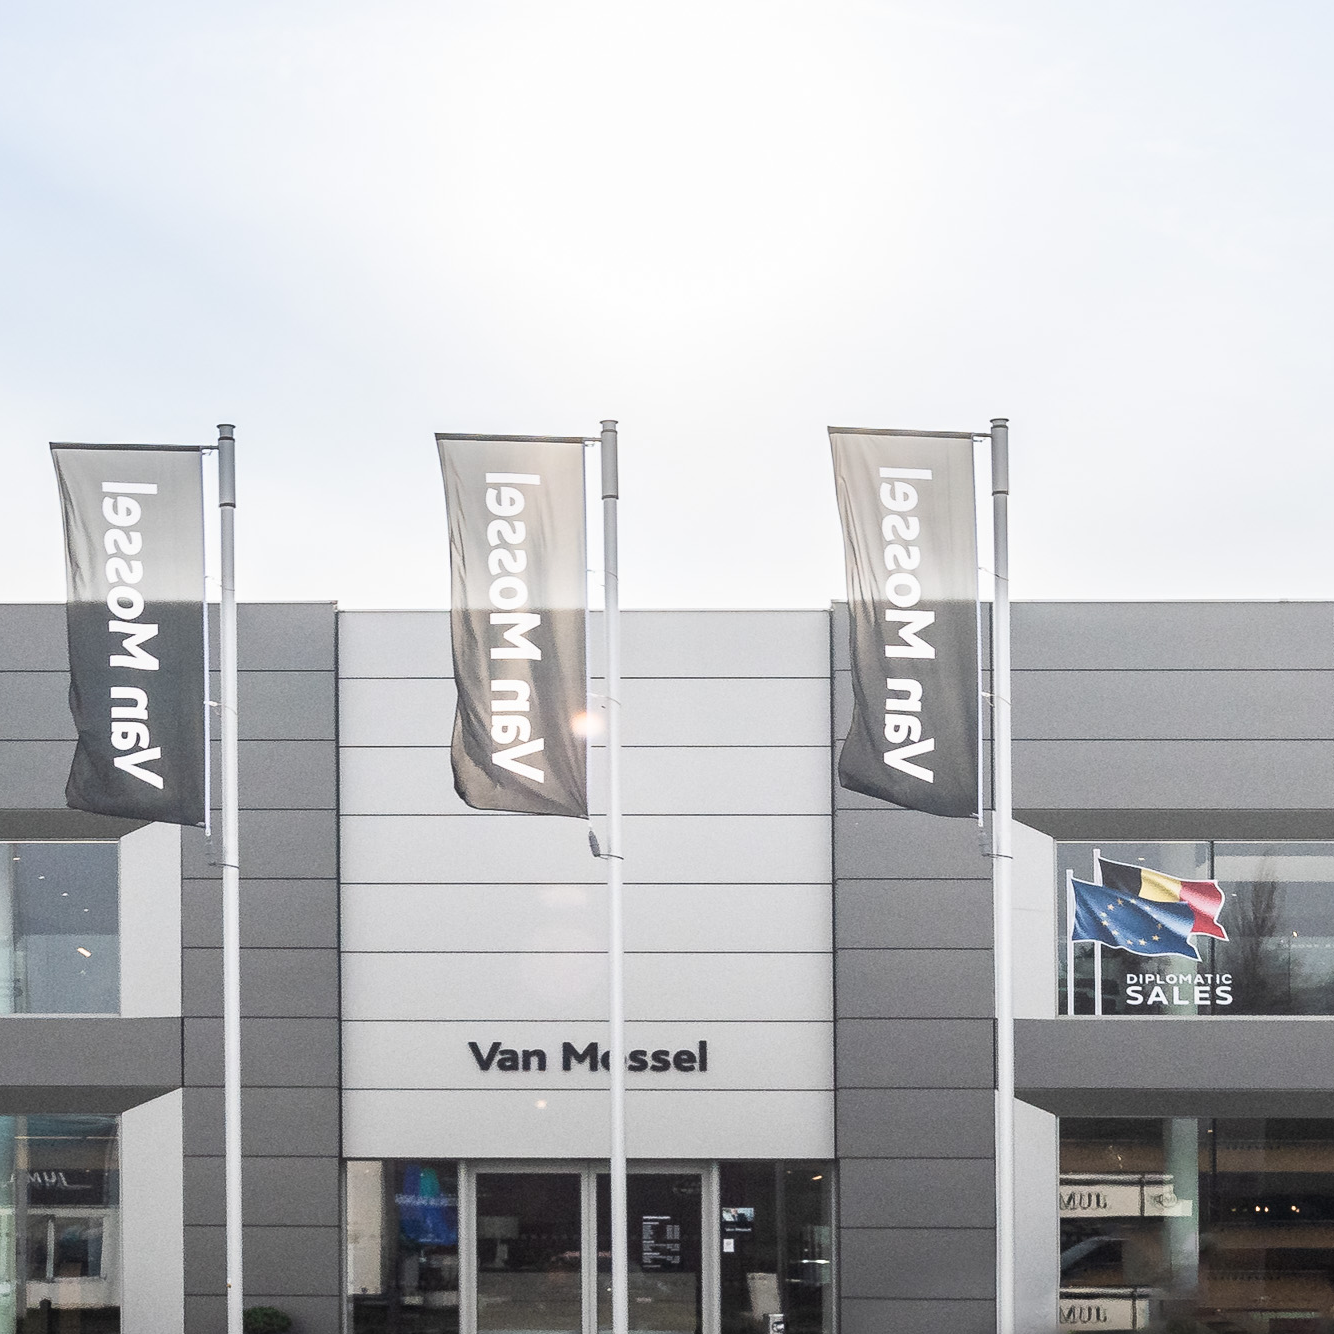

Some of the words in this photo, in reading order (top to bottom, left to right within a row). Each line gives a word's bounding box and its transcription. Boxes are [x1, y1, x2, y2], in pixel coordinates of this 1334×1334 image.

[1126, 973, 1233, 984] DIPLOMATIC
[1125, 986, 1234, 1005] SALES
[468, 1041, 547, 1072] Van
